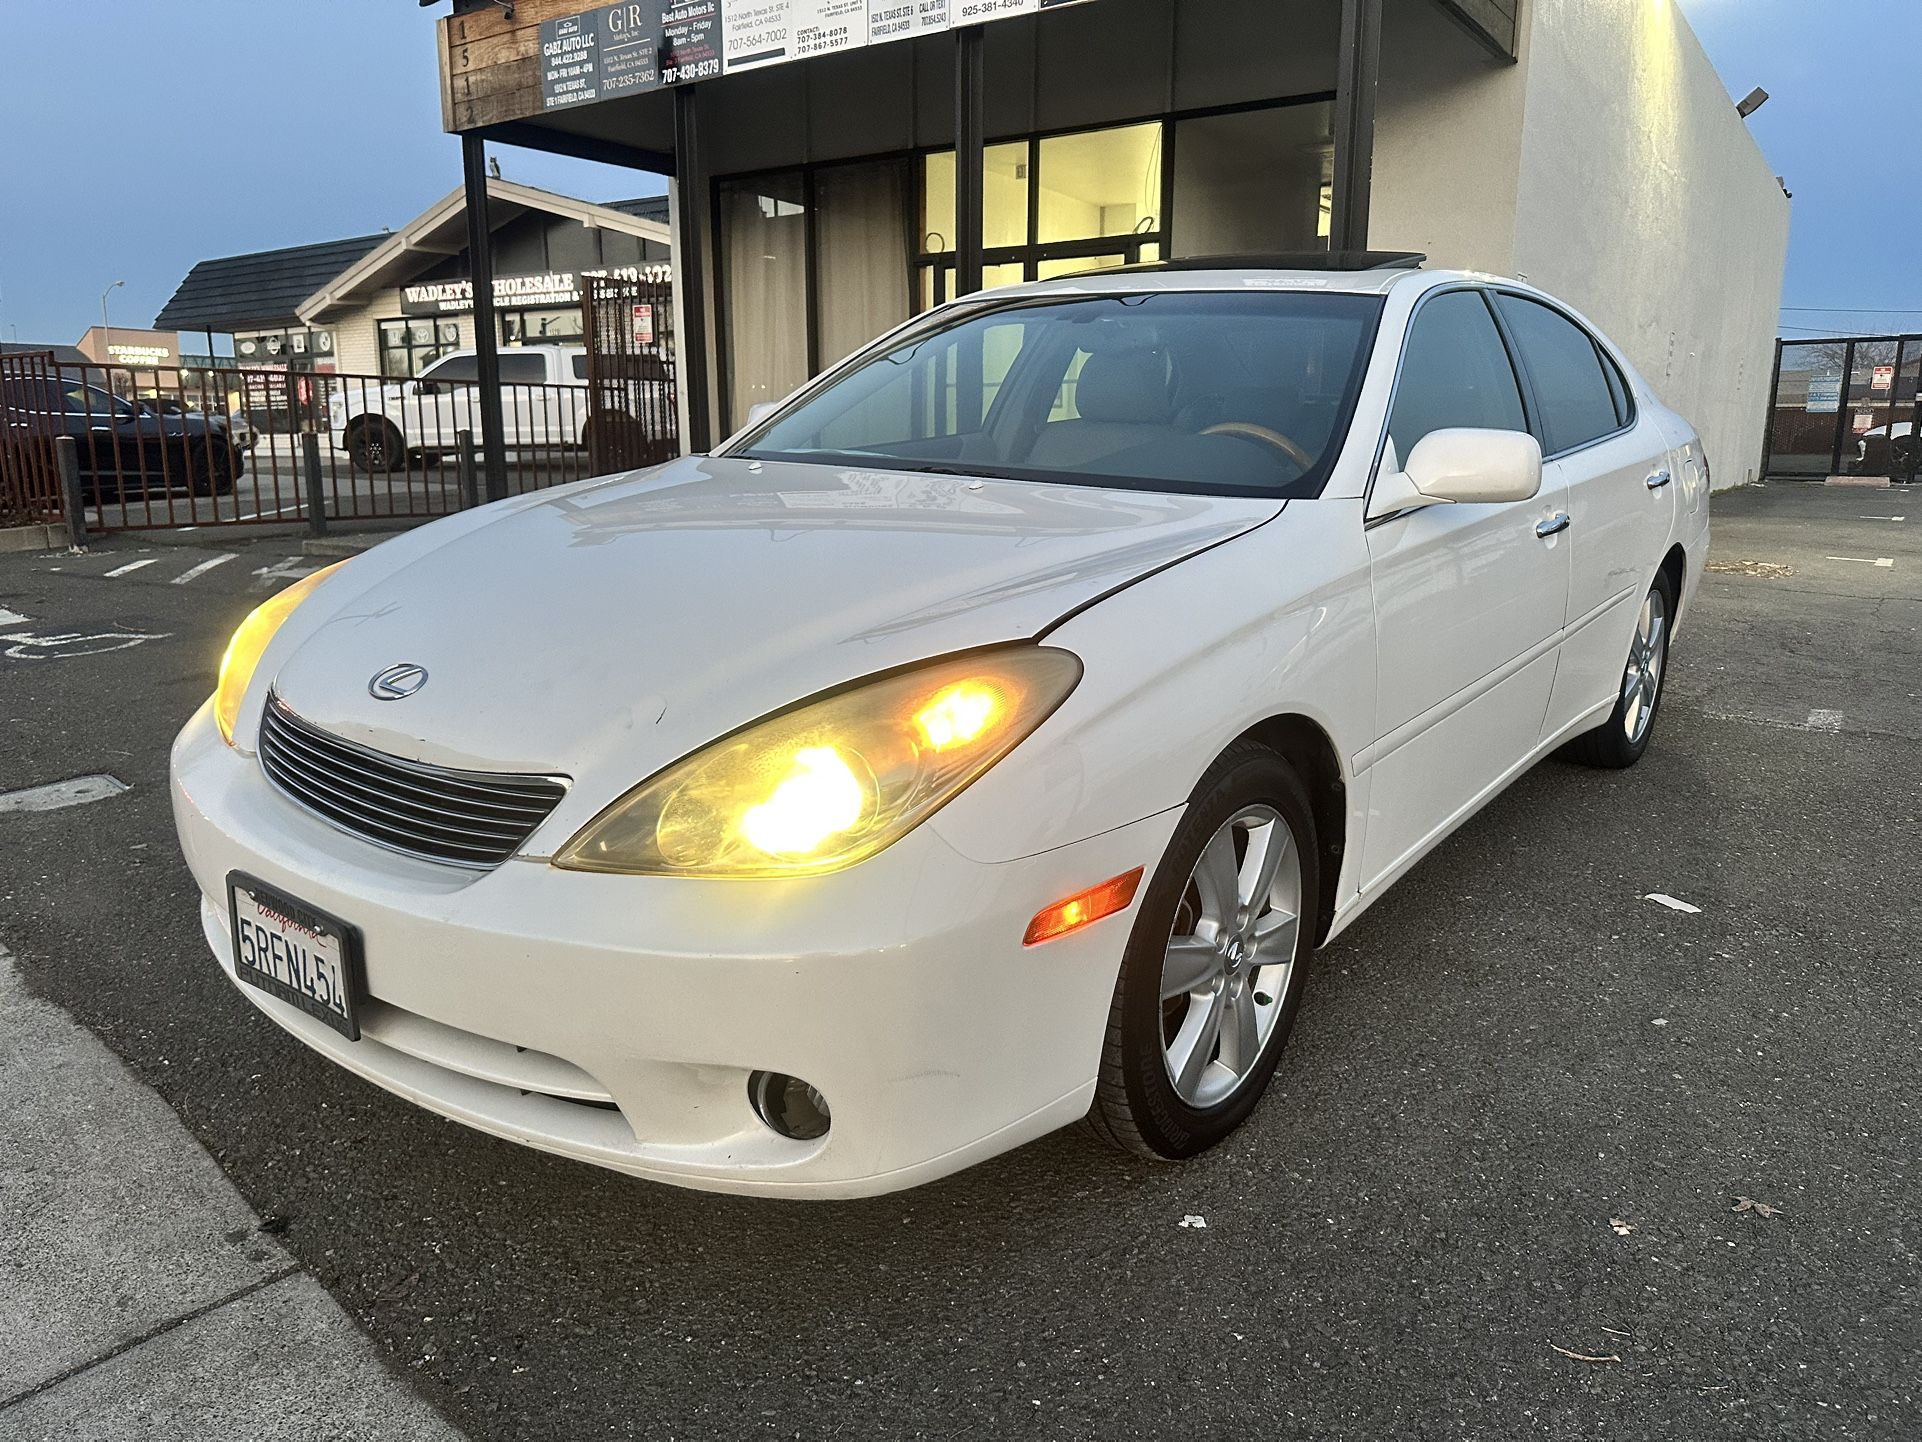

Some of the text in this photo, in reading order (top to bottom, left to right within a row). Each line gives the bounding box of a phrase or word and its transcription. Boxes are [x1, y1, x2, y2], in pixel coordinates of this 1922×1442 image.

[661, 12, 674, 24] Best
[674, 9, 688, 20] Auto
[688, 6, 706, 17] Motors
[725, 14, 737, 23] 1512
[738, 11, 752, 20] North
[754, 8, 768, 16] Texas
[883, 9, 896, 20] TEXAS
[919, 2, 929, 14] CALL
[929, 0, 936, 11] OR
[962, 0, 1024, 16] 925-381-4340
[665, 26, 688, 38] Monday
[693, 20, 712, 31] Friday
[754, 18, 763, 26] CA
[764, 14, 781, 23] 94533
[892, 22, 897, 32] CA
[672, 37, 686, 46] 8am
[690, 33, 704, 43] 5pm
[728, 28, 787, 51] 707-564-7002
[797, 26, 848, 44] 707-384-8078
[544, 33, 594, 56] GABZ AUTO LLC
[797, 36, 848, 54] 707-867-5577
[662, 58, 719, 84] 707-430-8379
[602, 70, 654, 91] 707-235-7362
[404, 280, 473, 302] WADLEY'S
[491, 273, 574, 296] HOLESALE
[438, 299, 474, 311] WADLEY'
[511, 292, 571, 306] REGISTRATION
[107, 345, 170, 358] STARBUCKS
[118, 354, 160, 366] COFFEE
[240, 916, 346, 1015] 5RFN454
[1139, 1040, 1191, 1150] BRIDGESTONE
